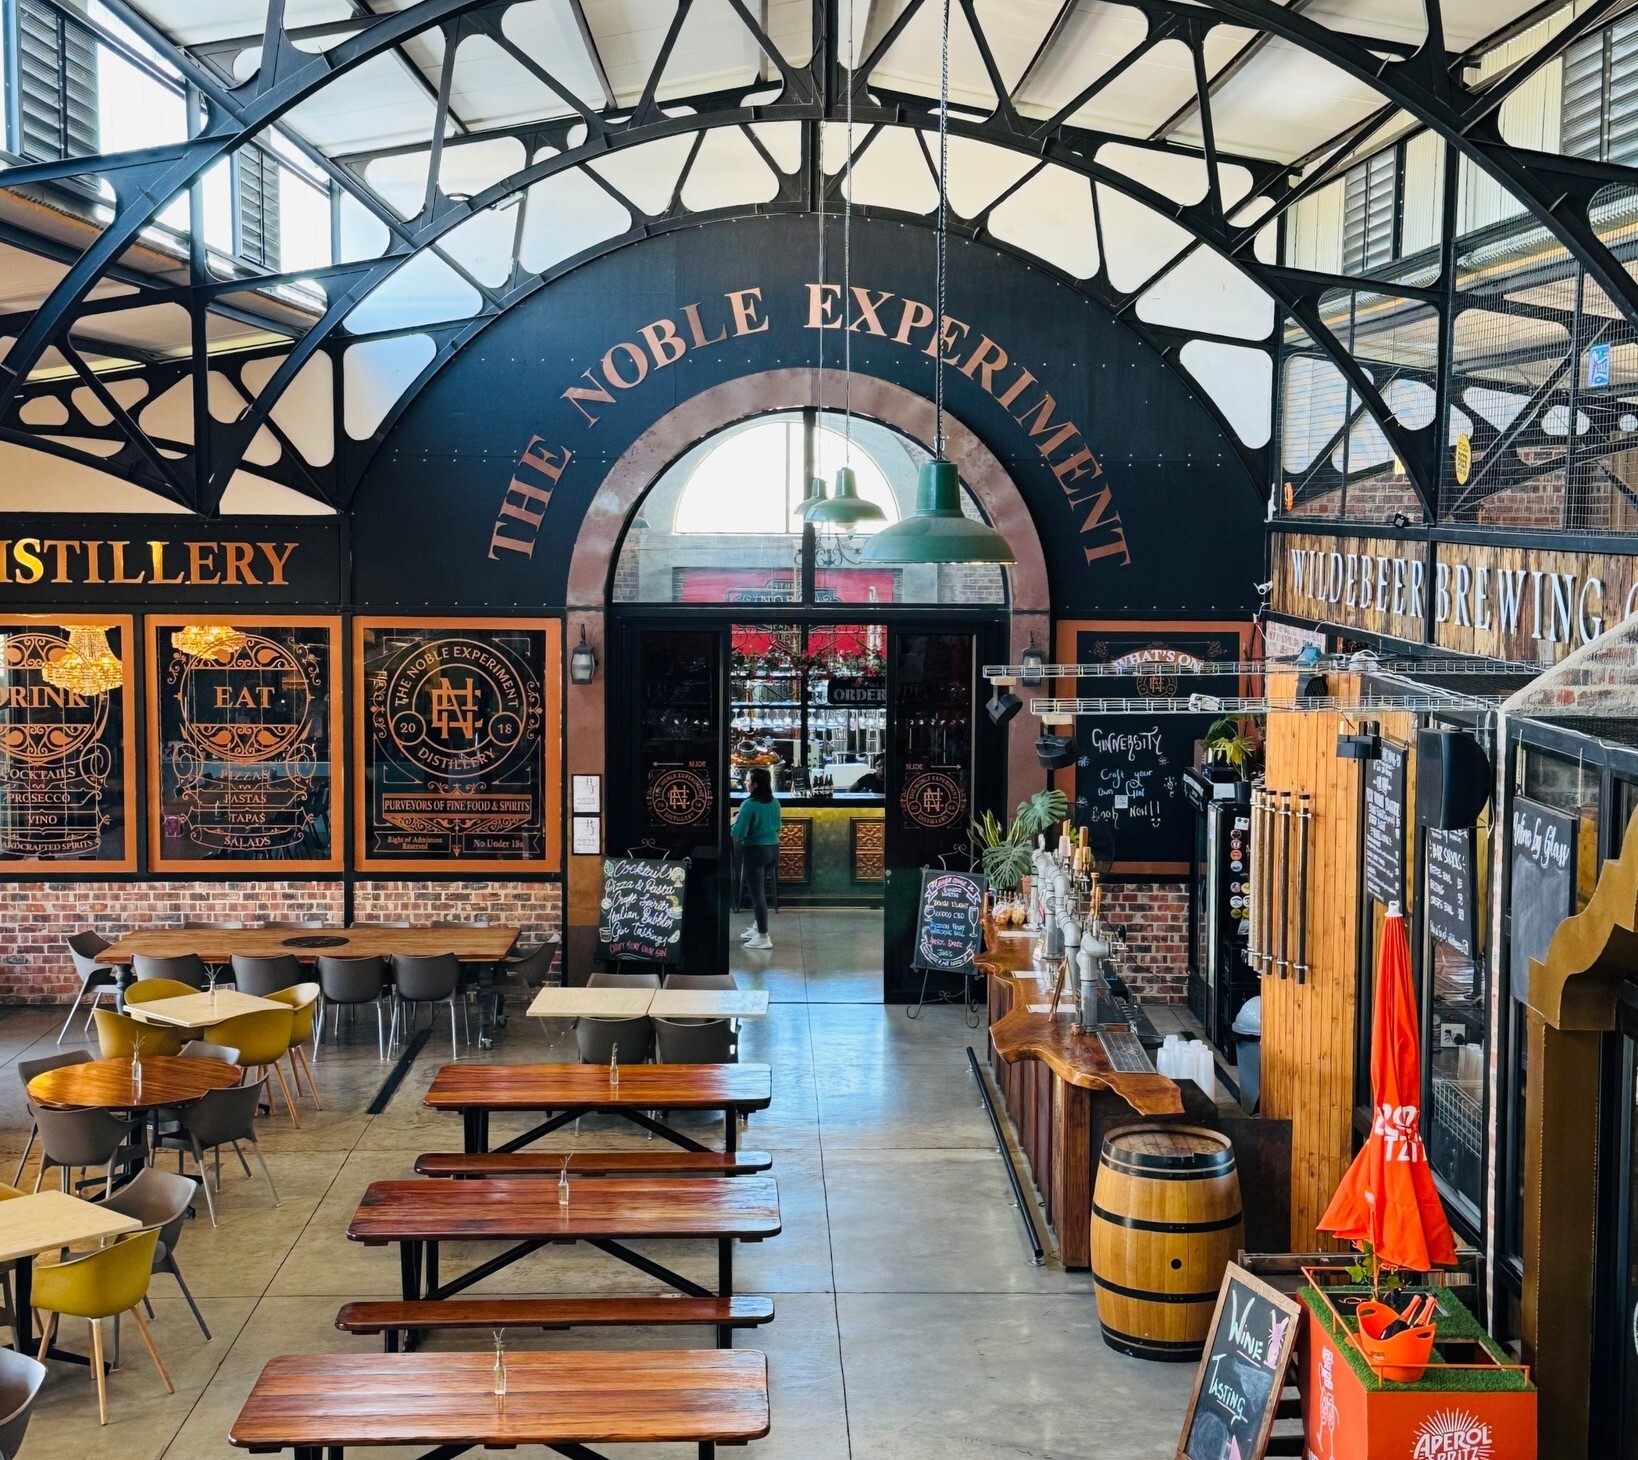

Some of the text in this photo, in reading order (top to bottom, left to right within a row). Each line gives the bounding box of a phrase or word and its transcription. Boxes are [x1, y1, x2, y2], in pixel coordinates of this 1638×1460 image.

[488, 283, 1131, 569] THE NOBLE EXPERIMENT
[1291, 549, 1424, 619] WILDEBEER
[1435, 563, 1604, 645] BREWING
[1111, 649, 1176, 669] WHAT'S
[395, 646, 519, 708] THE NOBLE EXPERIMENT
[213, 686, 275, 708] EAT
[400, 723, 416, 734] 20
[497, 724, 513, 734] 18
[418, 747, 496, 770] DISTILLERY
[8, 793, 70, 803] PROSECCO
[224, 793, 268, 804] PASTAS
[384, 799, 433, 811] PURVEYORS
[433, 799, 446, 810] OF
[446, 799, 467, 811] FINE
[467, 799, 491, 811] FOOD
[499, 799, 530, 811] SPIRITS
[29, 815, 57, 824] VINO
[229, 813, 266, 824] TAPAS
[62, 840, 93, 850] SPIRITS
[473, 839, 485, 848] No
[487, 839, 509, 848] Under
[613, 860, 673, 879] Cocktails
[605, 878, 634, 893] Pizza
[643, 878, 675, 896] Pasta
[612, 890, 638, 909] Craft
[607, 906, 674, 929] Italian Bubbles
[1413, 1426, 1493, 1460] APEROL
